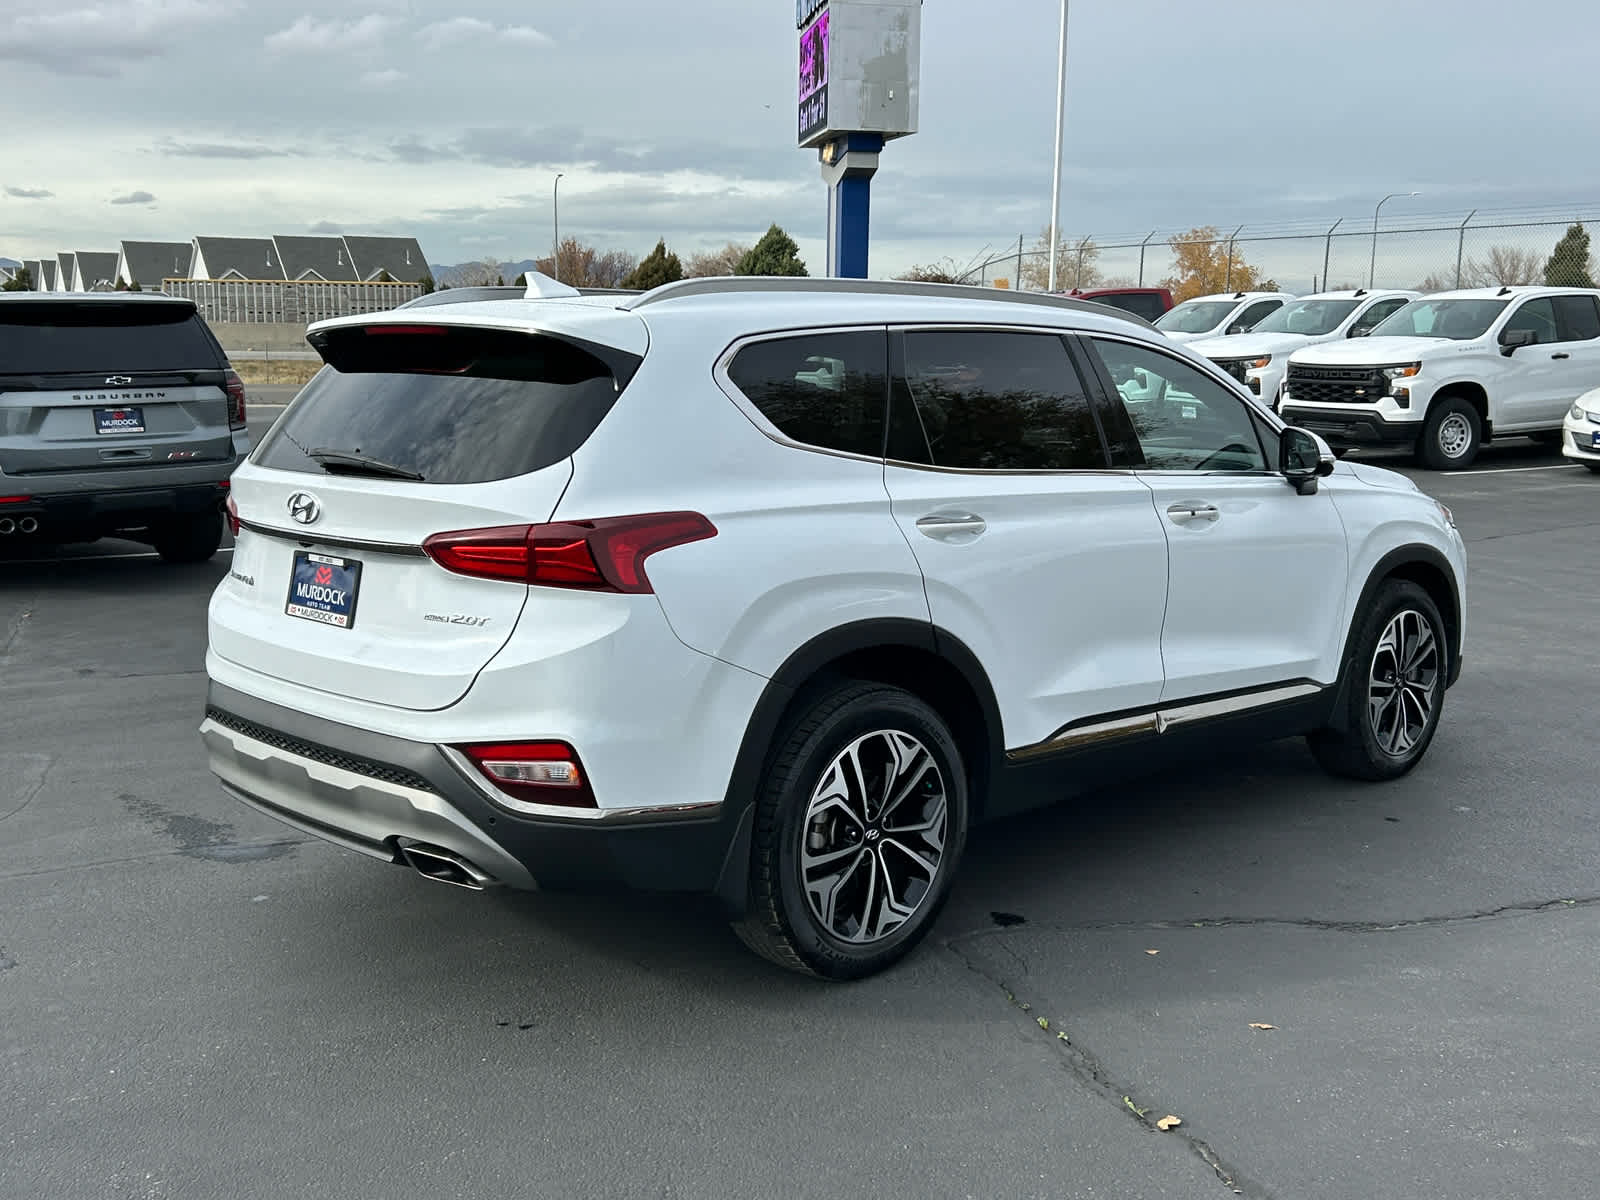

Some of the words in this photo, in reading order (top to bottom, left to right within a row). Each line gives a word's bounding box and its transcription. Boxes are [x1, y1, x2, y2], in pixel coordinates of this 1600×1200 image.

[72, 392, 166, 401] SUBURBAN
[296, 582, 346, 606] MURDOCK
[300, 608, 334, 622] MURDOCK
